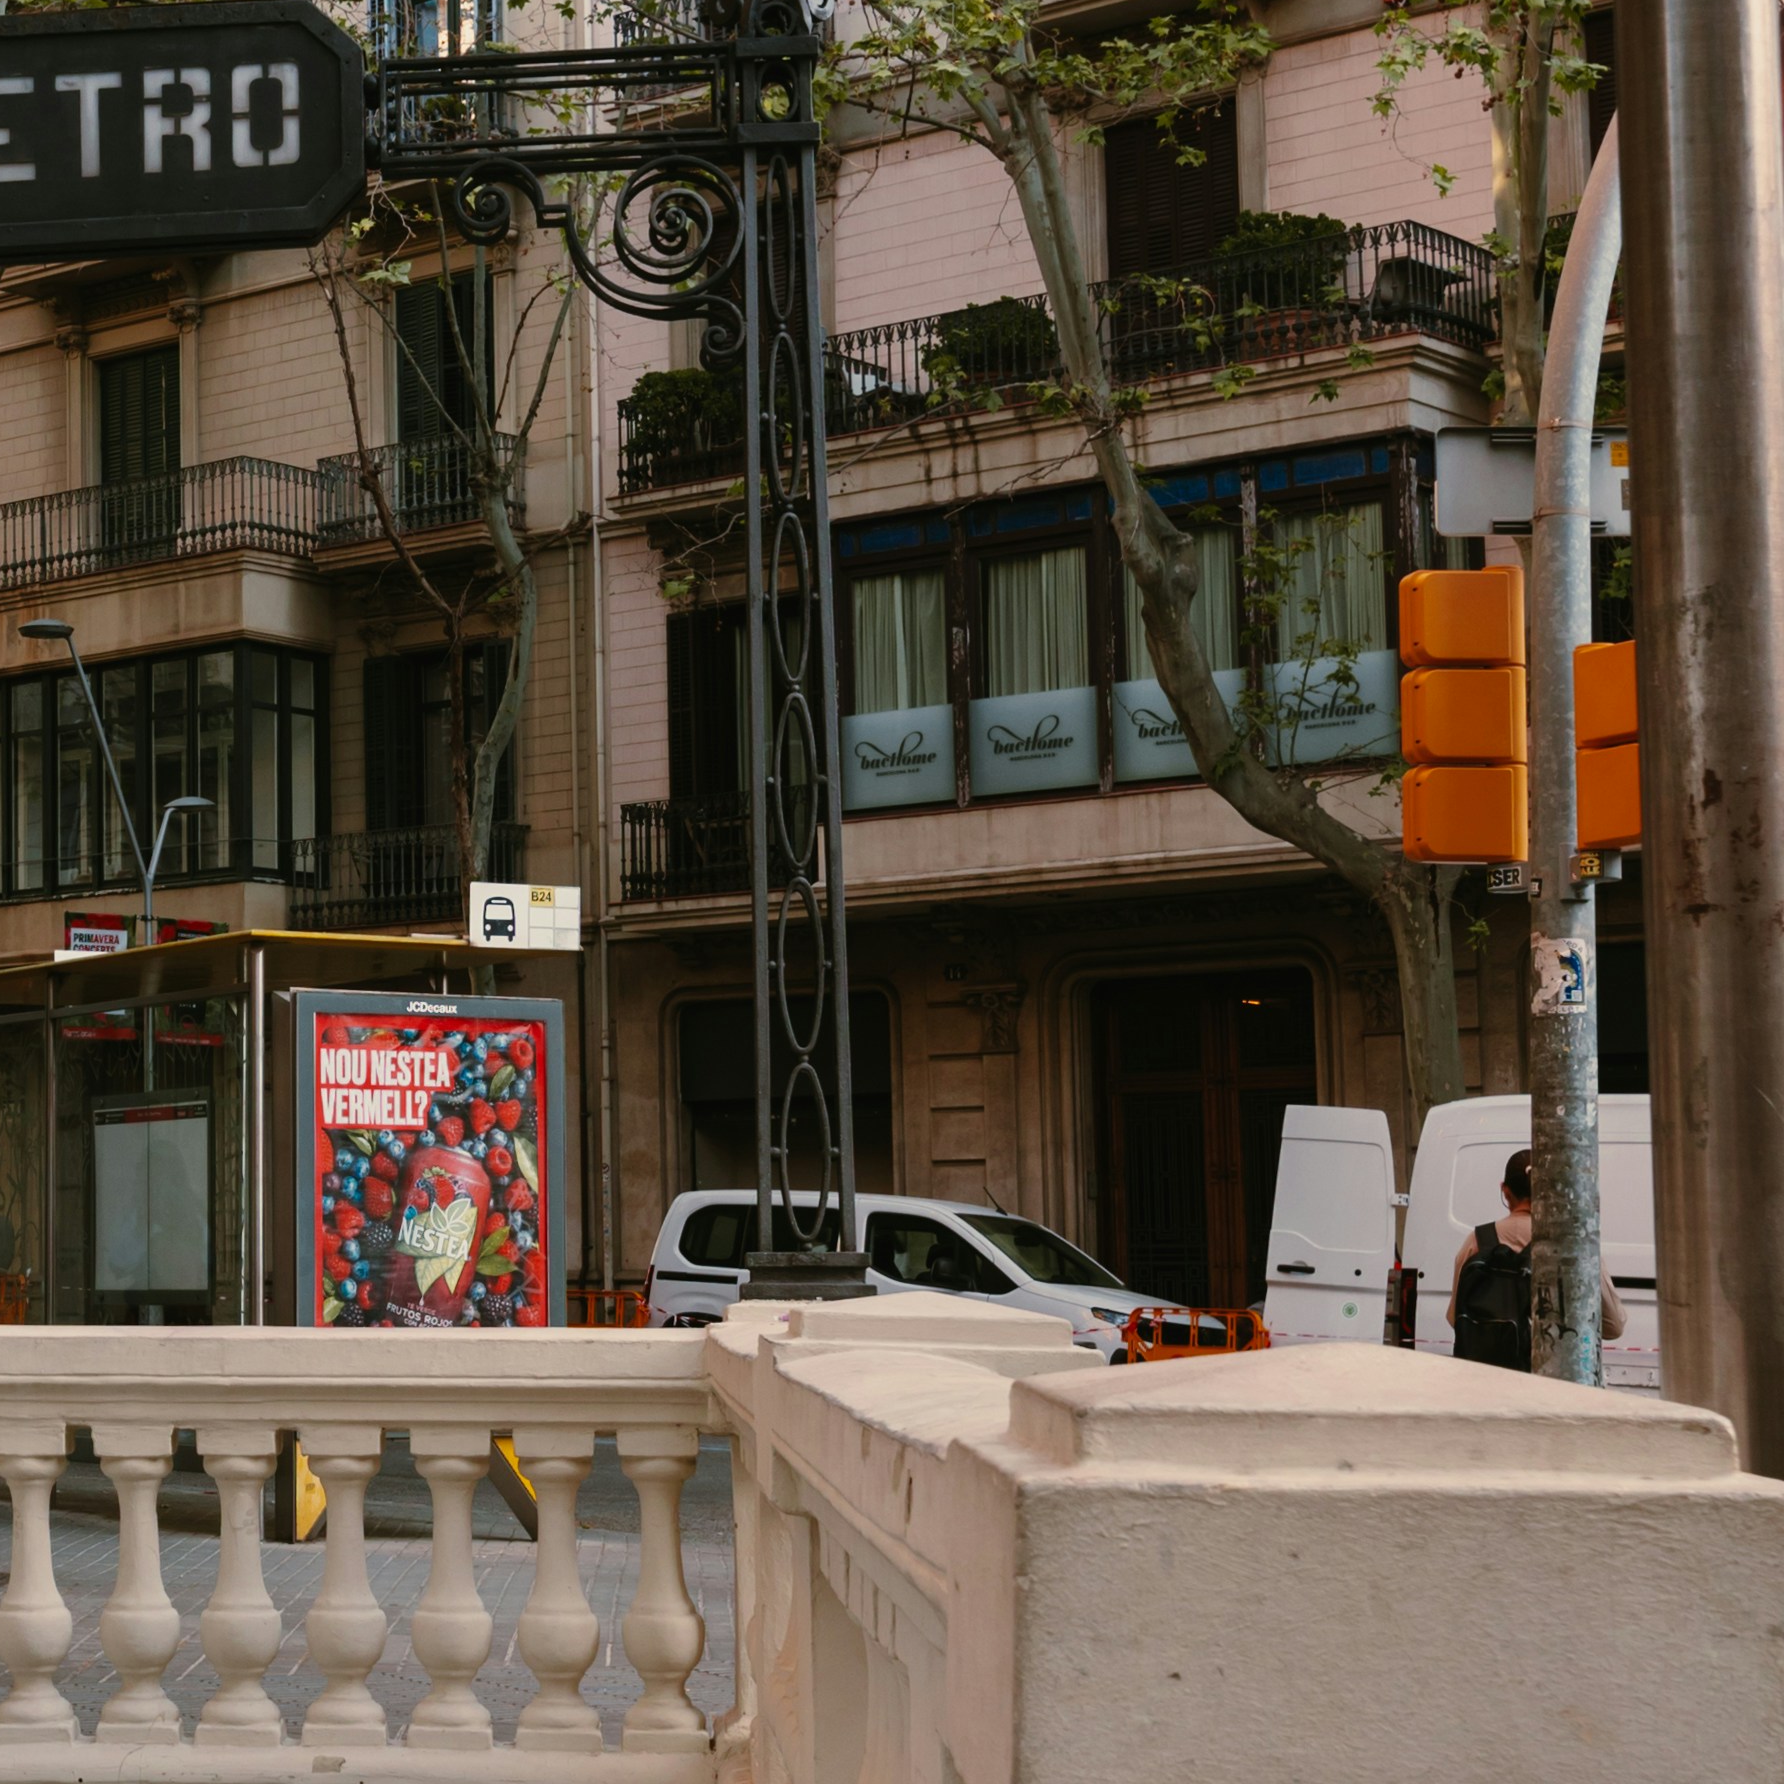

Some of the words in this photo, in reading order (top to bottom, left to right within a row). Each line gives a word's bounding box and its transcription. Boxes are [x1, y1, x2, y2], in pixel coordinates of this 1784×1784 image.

[531, 891, 552, 902] B24
[73, 932, 119, 945] PRIMAVERA
[406, 1000, 458, 1014] JCDecaux
[320, 1047, 367, 1086] NOU
[370, 1049, 451, 1088] NESTEA
[320, 1087, 428, 1127] VERMELL?
[397, 1216, 469, 1261] NESTEA
[386, 1301, 422, 1322] FRUTOS
